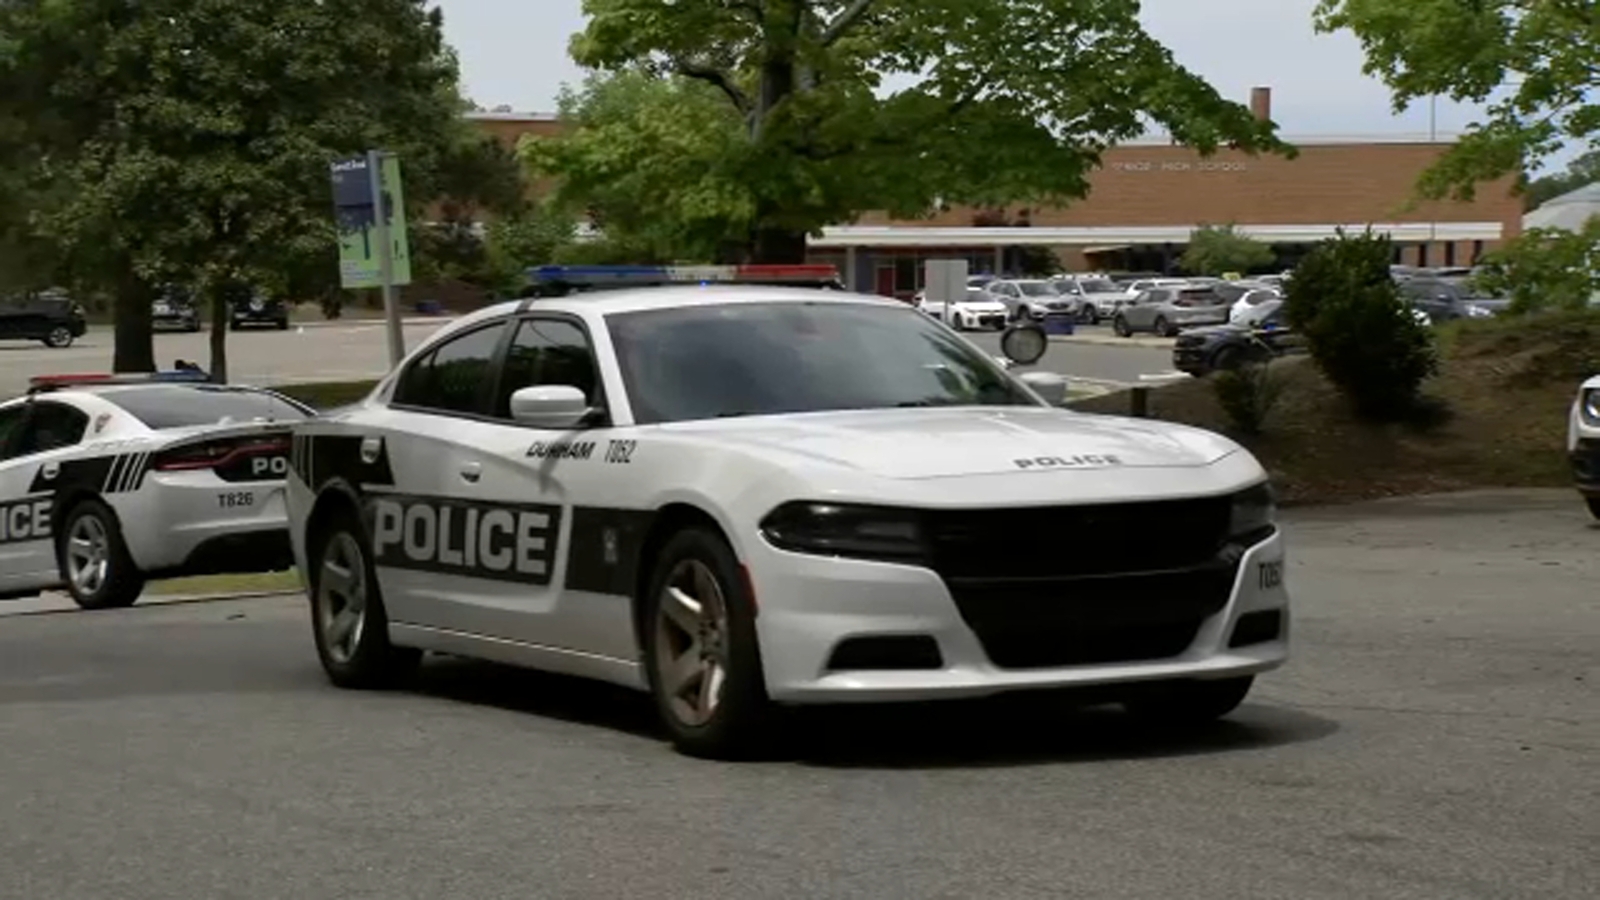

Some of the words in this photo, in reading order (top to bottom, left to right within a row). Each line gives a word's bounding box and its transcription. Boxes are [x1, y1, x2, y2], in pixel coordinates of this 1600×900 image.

[525, 441, 596, 460] DURHAM
[604, 439, 637, 463] T052
[1013, 454, 1121, 469] POLICE
[218, 492, 253, 508] T826
[374, 500, 550, 575] POLICE
